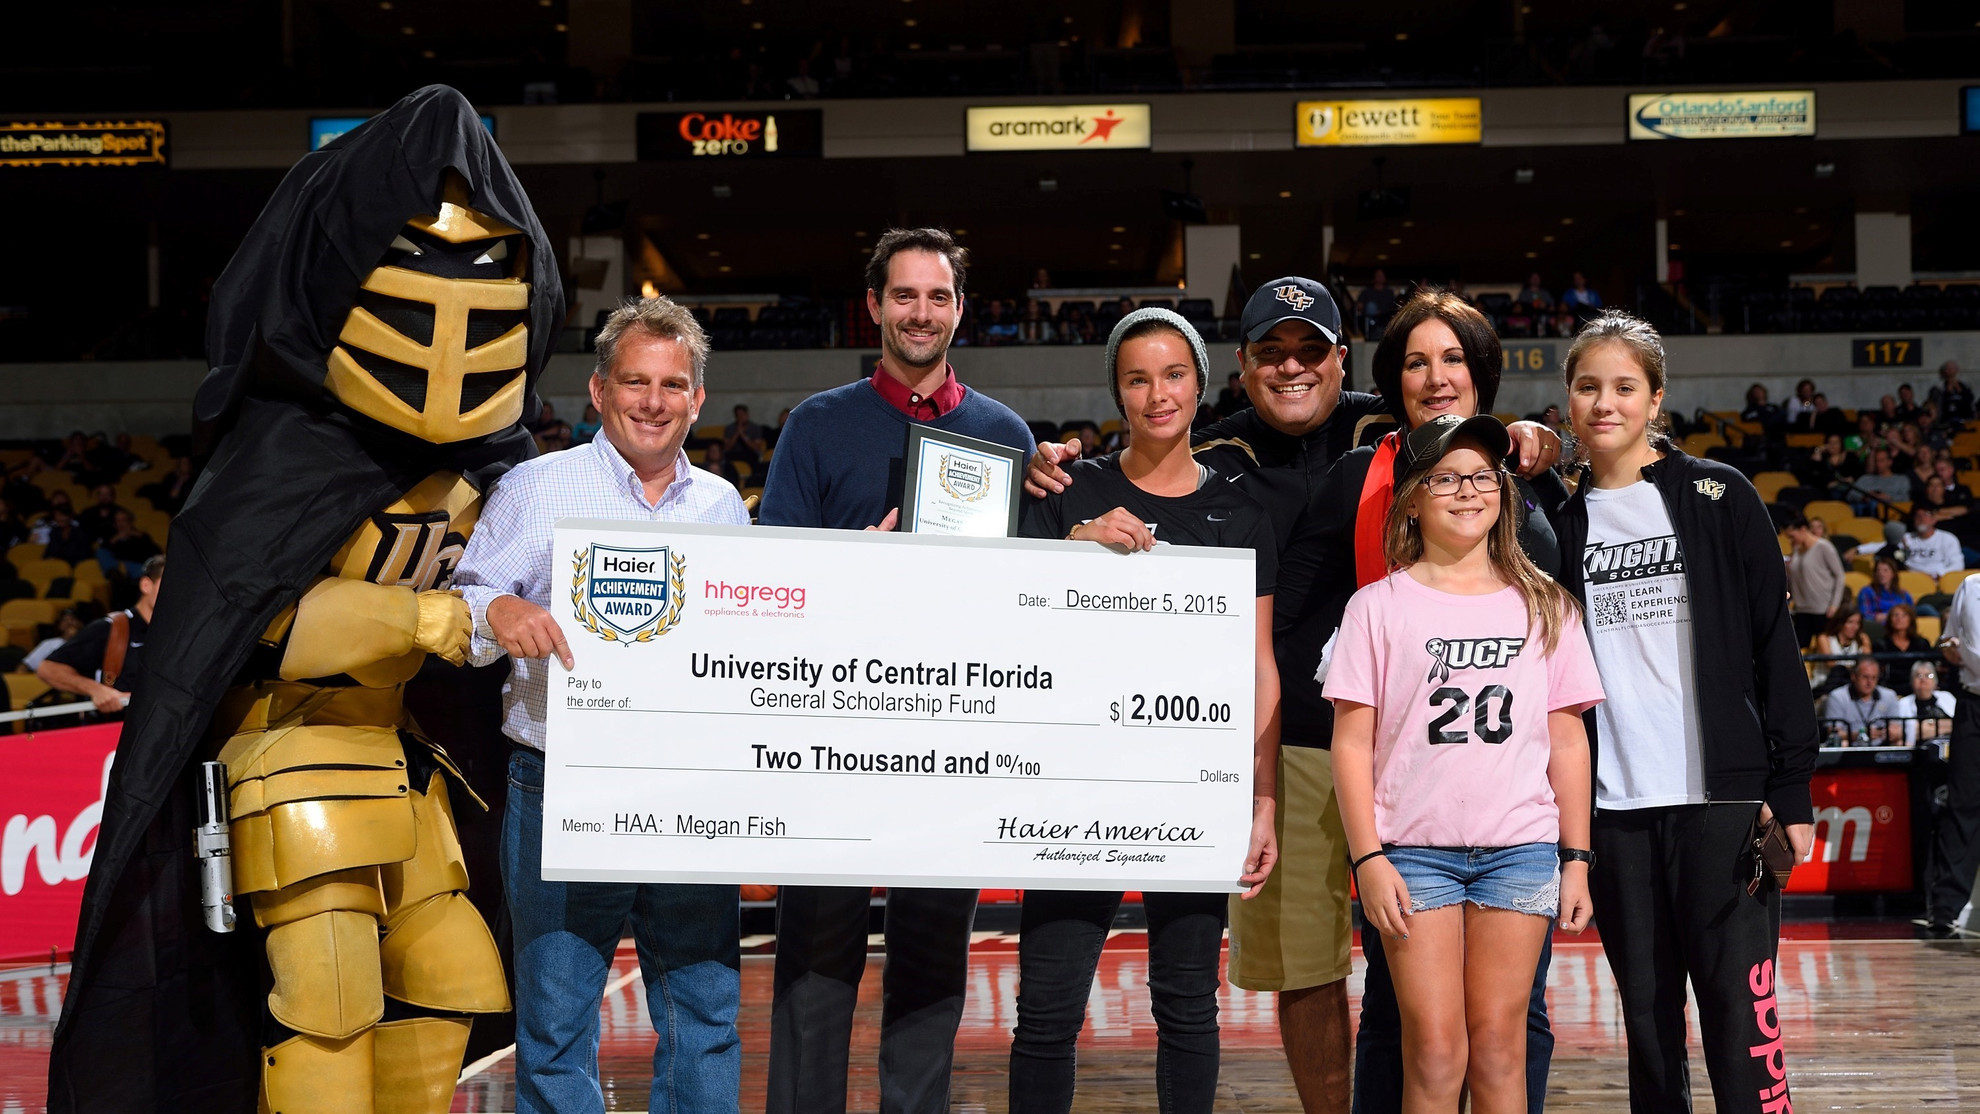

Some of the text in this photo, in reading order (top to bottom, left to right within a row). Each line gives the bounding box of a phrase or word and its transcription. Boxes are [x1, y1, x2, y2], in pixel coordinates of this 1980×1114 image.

[678, 112, 761, 142] Coke
[989, 116, 1086, 137] aramark
[1336, 105, 1421, 134] Jewett
[691, 139, 749, 156] zero
[1273, 285, 1315, 311] UCF
[1502, 348, 1544, 371] 116
[1865, 342, 1910, 364] 117
[953, 460, 978, 472] Haier
[953, 480, 976, 492] AWARD
[1693, 478, 1726, 500] UCF
[919, 517, 949, 531] University
[603, 556, 657, 574] Haier
[1583, 536, 1682, 579] KNIGHT
[1608, 562, 1683, 580] SOCCER
[592, 580, 665, 598] ACHIEVEMENT
[704, 579, 806, 610] hhgregg
[1629, 585, 1663, 598] LEARN
[604, 600, 653, 617] AWARD
[1018, 589, 1227, 615] Date: December 5, 2015
[1631, 595, 1688, 610] EXPERIENC
[704, 607, 805, 619] appliances & electronics
[1632, 608, 1673, 622] INSPIRE
[1444, 637, 1526, 670] UCF
[691, 653, 1053, 690] University of Central Florida
[567, 676, 602, 691] Pay to
[567, 695, 632, 709] the order of:
[750, 688, 996, 718] General Scholarship Fund
[1109, 693, 1232, 726] $ 2,000.00
[1428, 684, 1514, 746] 20
[752, 744, 1041, 777] Two Thousand and 00/100
[1199, 769, 1240, 784] Dollars
[562, 813, 786, 840] Memo: HAA: Megan Fish
[997, 816, 1206, 842] Haier America
[1033, 847, 1167, 867] Authorized Signature
